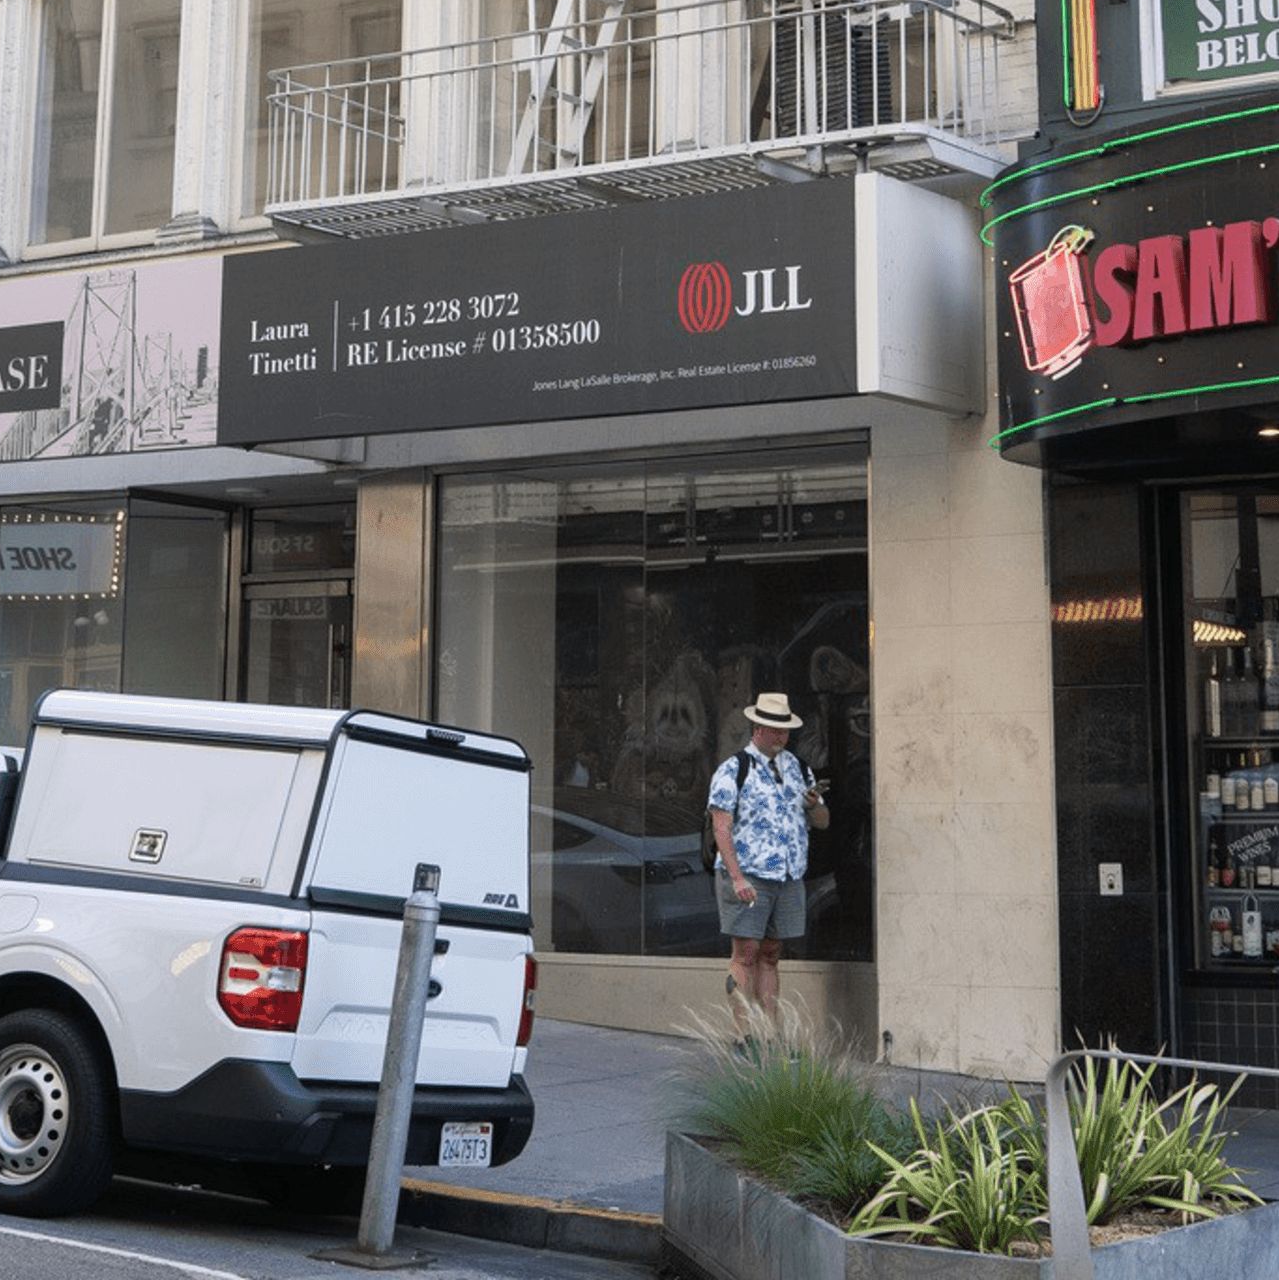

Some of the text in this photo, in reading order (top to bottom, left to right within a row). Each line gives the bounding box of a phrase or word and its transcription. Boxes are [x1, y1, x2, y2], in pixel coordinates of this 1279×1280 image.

[734, 265, 813, 317] JLL
[348, 292, 519, 332] +1 415 228 3072
[250, 320, 310, 343] Laura
[347, 319, 601, 367] RE License # 01358500
[250, 348, 318, 375] Tinetti
[532, 379, 557, 391] Jones
[558, 378, 580, 390] Lang
[580, 374, 611, 388] LaSalle
[613, 370, 659, 385] Brokerage,
[660, 369, 675, 380] Inc.
[678, 367, 697, 378] Real
[698, 364, 726, 376] Estate
[727, 361, 762, 374] License
[1227, 826, 1279, 856] PREMIUM
[1238, 841, 1272, 862] WINES
